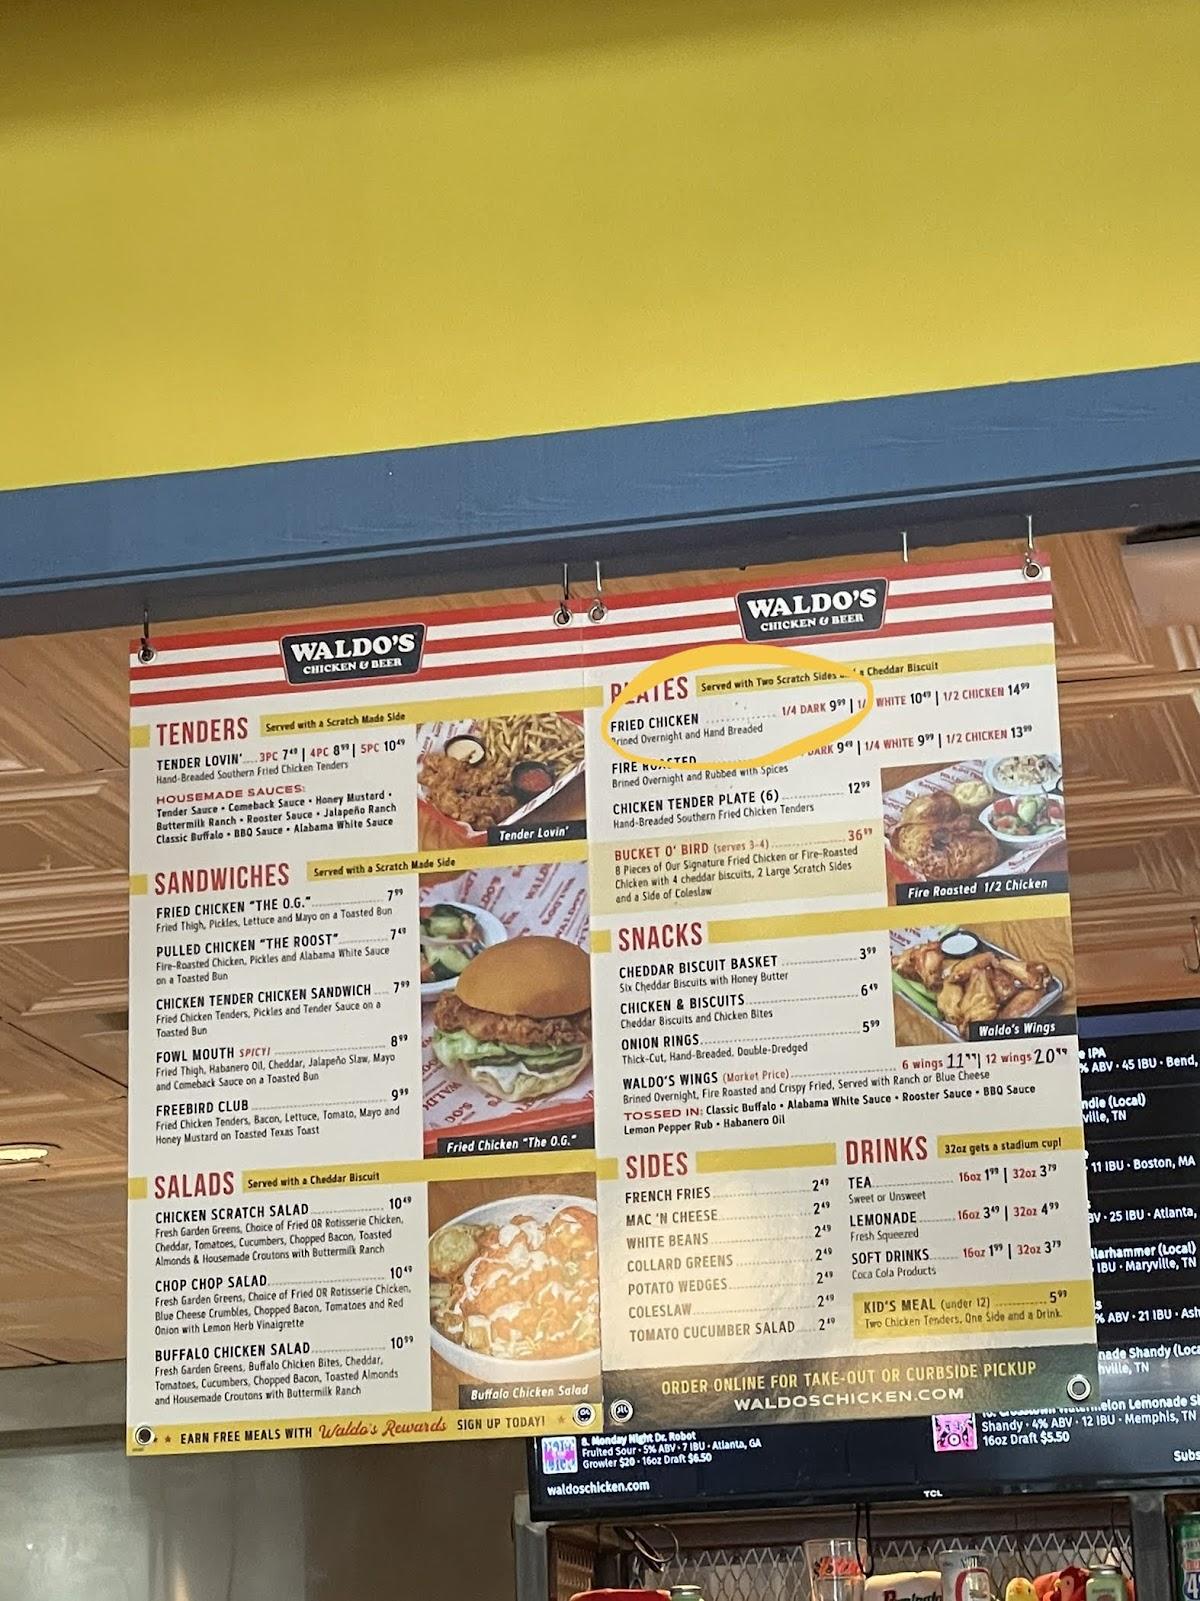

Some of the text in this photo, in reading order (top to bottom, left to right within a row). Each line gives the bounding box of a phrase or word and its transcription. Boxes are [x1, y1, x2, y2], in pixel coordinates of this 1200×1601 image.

[760, 617, 816, 631] CHICKEN
[831, 613, 864, 624] BEER
[303, 661, 356, 674] CHICKEN
[371, 657, 402, 668] BEER
[782, 705, 796, 716] 1/4
[800, 703, 826, 714] DARK
[266, 720, 295, 732] Served
[297, 719, 316, 729] with
[326, 715, 359, 727] Scratch
[362, 713, 384, 723] Made
[387, 712, 405, 721] Side
[610, 713, 698, 732] FRIED CHICKEN
[156, 717, 247, 746] TENDERS
[156, 757, 200, 770] TENDER
[217, 768, 254, 779] Southern
[257, 764, 279, 776] Fried
[281, 763, 313, 773] Chicken
[316, 760, 348, 771] Tenders
[156, 789, 243, 804] HOUSEMADE
[613, 789, 778, 814] CHICKEN TENDER PLATE (6)
[500, 828, 534, 840] Tender
[154, 863, 289, 895] SANDWICHES
[908, 879, 1047, 898] Fire Roasted 1/2 Chicken
[156, 905, 190, 918] FRIED
[195, 901, 244, 916] CHICKEN
[618, 922, 702, 951] SNACKS
[1024, 1022, 1055, 1035] Wings
[621, 1033, 699, 1050] ONION RINGS
[156, 1050, 187, 1063] FOWL
[192, 1047, 234, 1060] MOUTH
[986, 1052, 1032, 1064] 12 wings
[912, 1058, 943, 1071] wings
[624, 1114, 785, 1135] Lemon Pepper Rub Habanero Oil
[447, 1140, 475, 1153] Fried
[478, 1138, 518, 1151] Chicken
[846, 1135, 927, 1165] DRINKS
[945, 1144, 966, 1153] 32oz
[969, 1143, 989, 1155] gets
[1001, 1139, 1038, 1150] stadium
[626, 1152, 687, 1179] SIDES
[154, 1171, 234, 1199] SALADS
[848, 1176, 871, 1189] TEA
[625, 1186, 710, 1203] FRENCH FRIES
[156, 1203, 308, 1223] CHICKEN SCRATCH SALAD
[850, 1211, 916, 1227] LEMONADE
[850, 1227, 919, 1242] Fresh Squeezed
[852, 1248, 929, 1264] SOFT DRINKS
[628, 1303, 691, 1319] COLESLAW
[901, 1298, 935, 1311] MEAL
[940, 1299, 972, 1311] (under
[976, 1296, 990, 1309] 12)
[154, 1319, 304, 1335] Onion with Lemon Herb Vinaigrette
[662, 1379, 708, 1394] ORDER
[714, 1375, 765, 1391] ONLINE
[770, 1374, 797, 1390] FOR
[882, 1368, 899, 1382] OR
[906, 1364, 981, 1381] CURBSIDE
[984, 1361, 1036, 1377] PICKUP
[470, 1384, 588, 1402] Buffalo Chicken Salad
[733, 1388, 963, 1411] WALDOSCHICKEN.COM
[381, 1416, 446, 1437] Rewards
[457, 1418, 482, 1430] SIGN
[486, 1418, 500, 1429] UP
[180, 1427, 311, 1444] EARN FREE MEALS WITH
